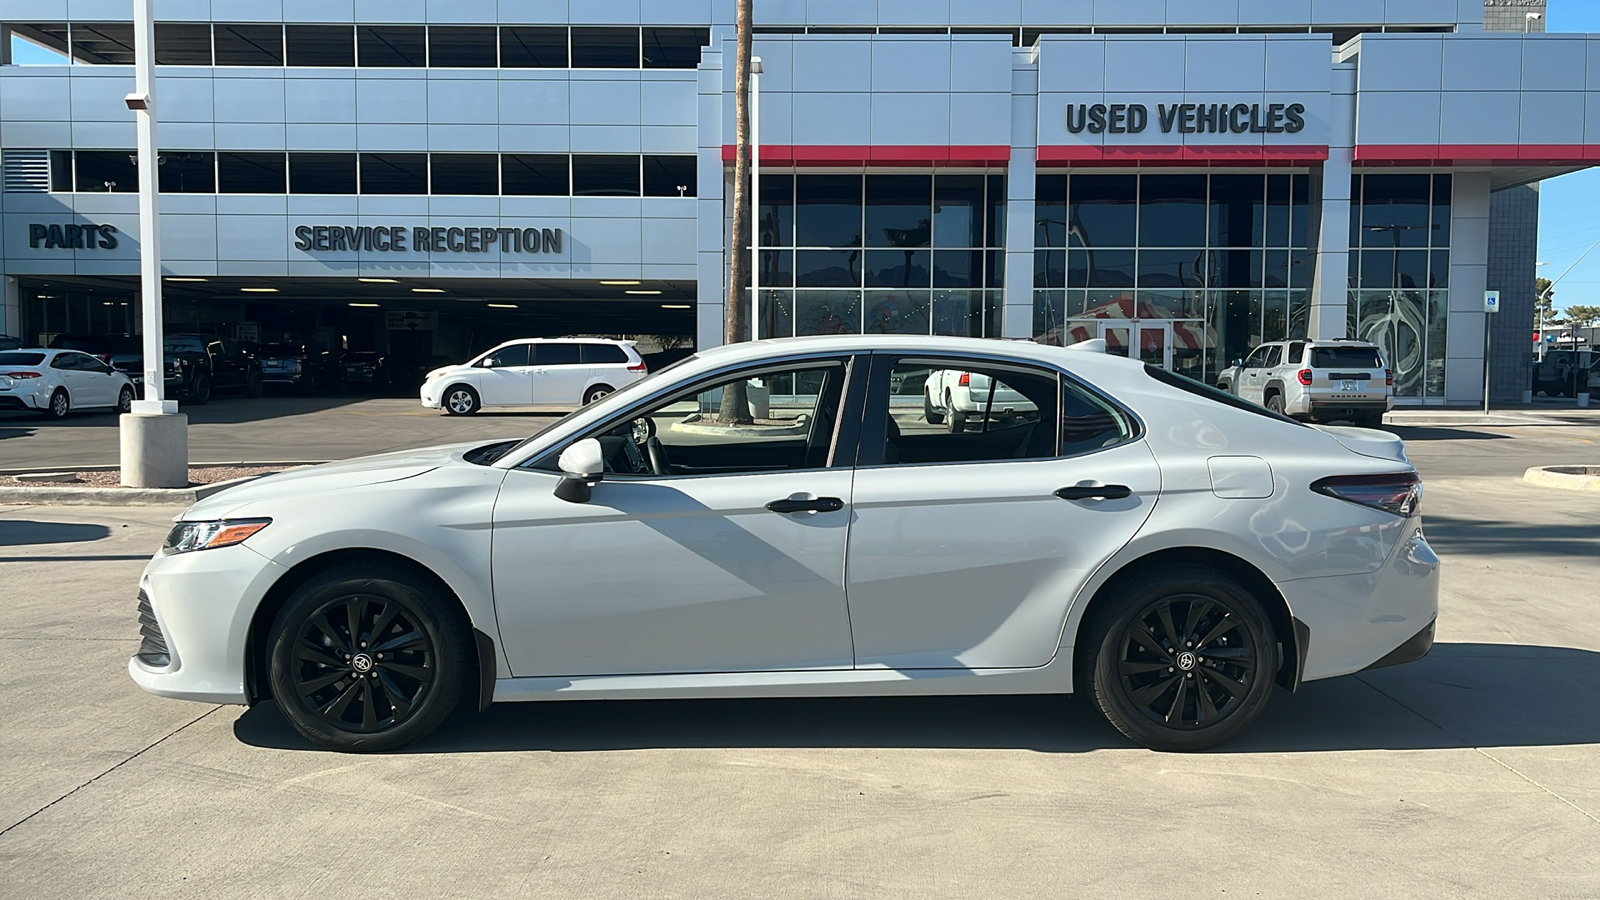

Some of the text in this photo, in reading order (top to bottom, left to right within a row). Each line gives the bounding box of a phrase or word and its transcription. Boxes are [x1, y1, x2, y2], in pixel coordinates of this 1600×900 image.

[1066, 103, 1305, 133] USED VEHICLES
[29, 223, 118, 249] PARTS
[294, 225, 562, 253] SERVICE RECEPTION
